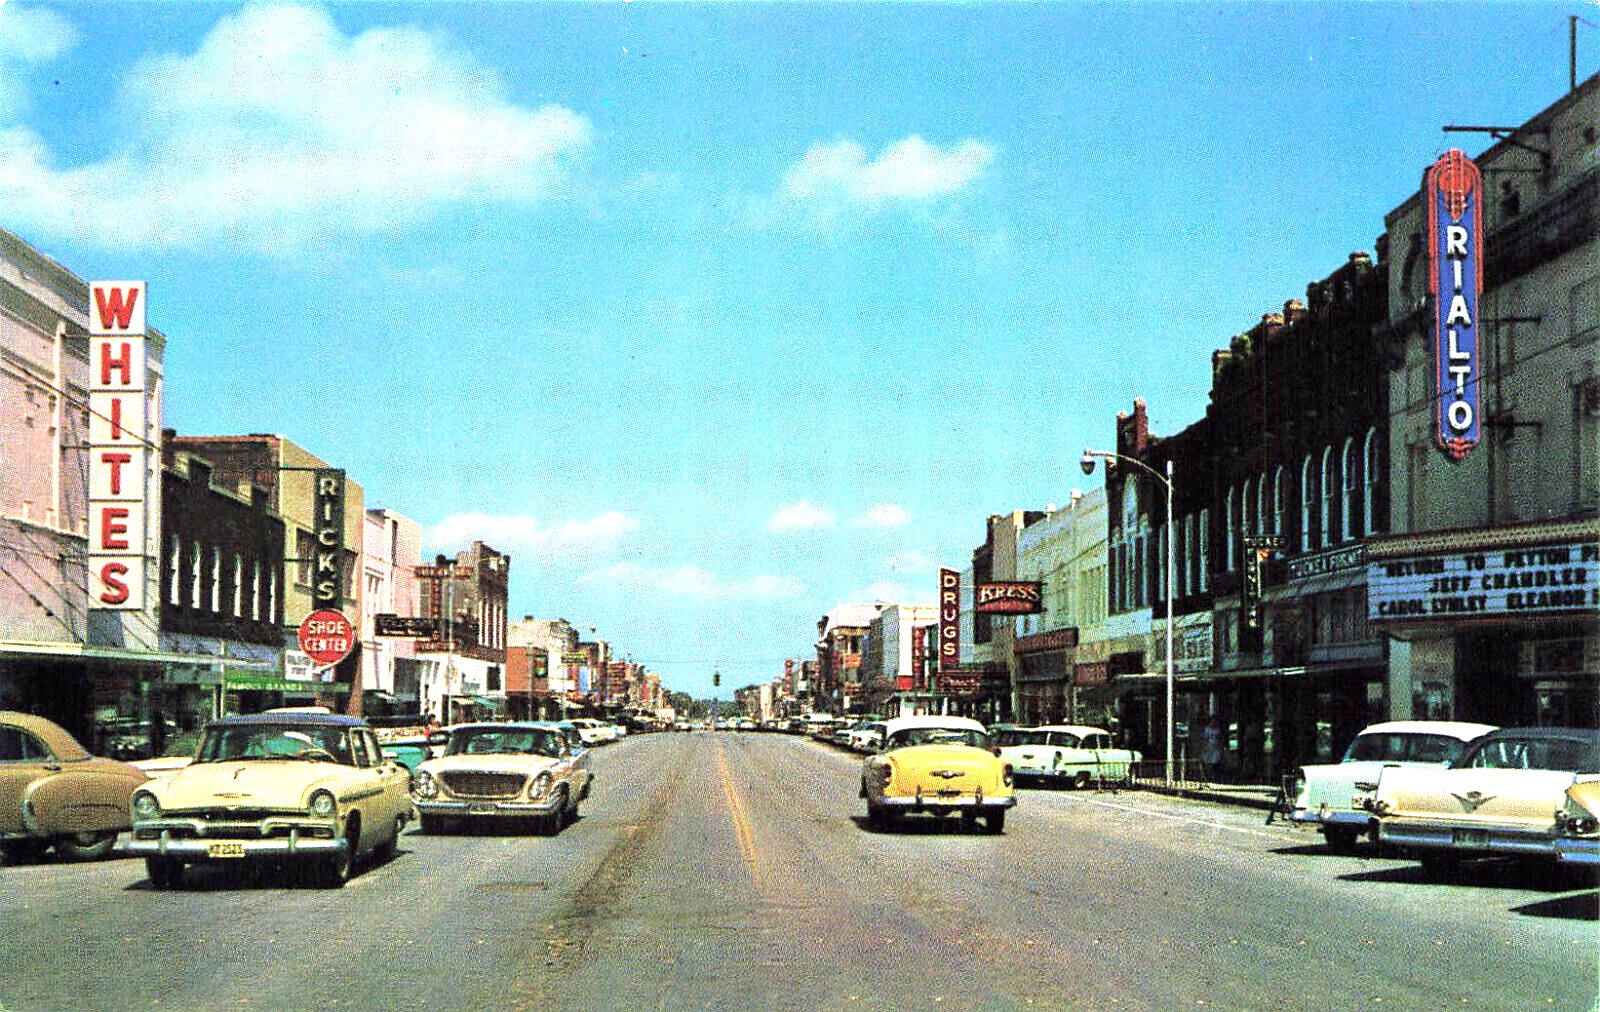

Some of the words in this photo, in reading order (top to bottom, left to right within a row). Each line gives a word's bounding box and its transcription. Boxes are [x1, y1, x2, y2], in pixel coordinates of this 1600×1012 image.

[1446, 225, 1472, 431] RIALTO
[94, 287, 139, 605] WHITES
[317, 478, 340, 601] RICKS
[1464, 555, 1486, 571] TO
[1429, 575, 1472, 593] JEFF
[1481, 568, 1587, 590] CHANDLER
[979, 585, 1041, 603] KRESS
[943, 574, 957, 656] DRUGS
[1379, 598, 1428, 616] CAROL
[307, 620, 345, 635] SHOE
[304, 637, 348, 652] CENTER
